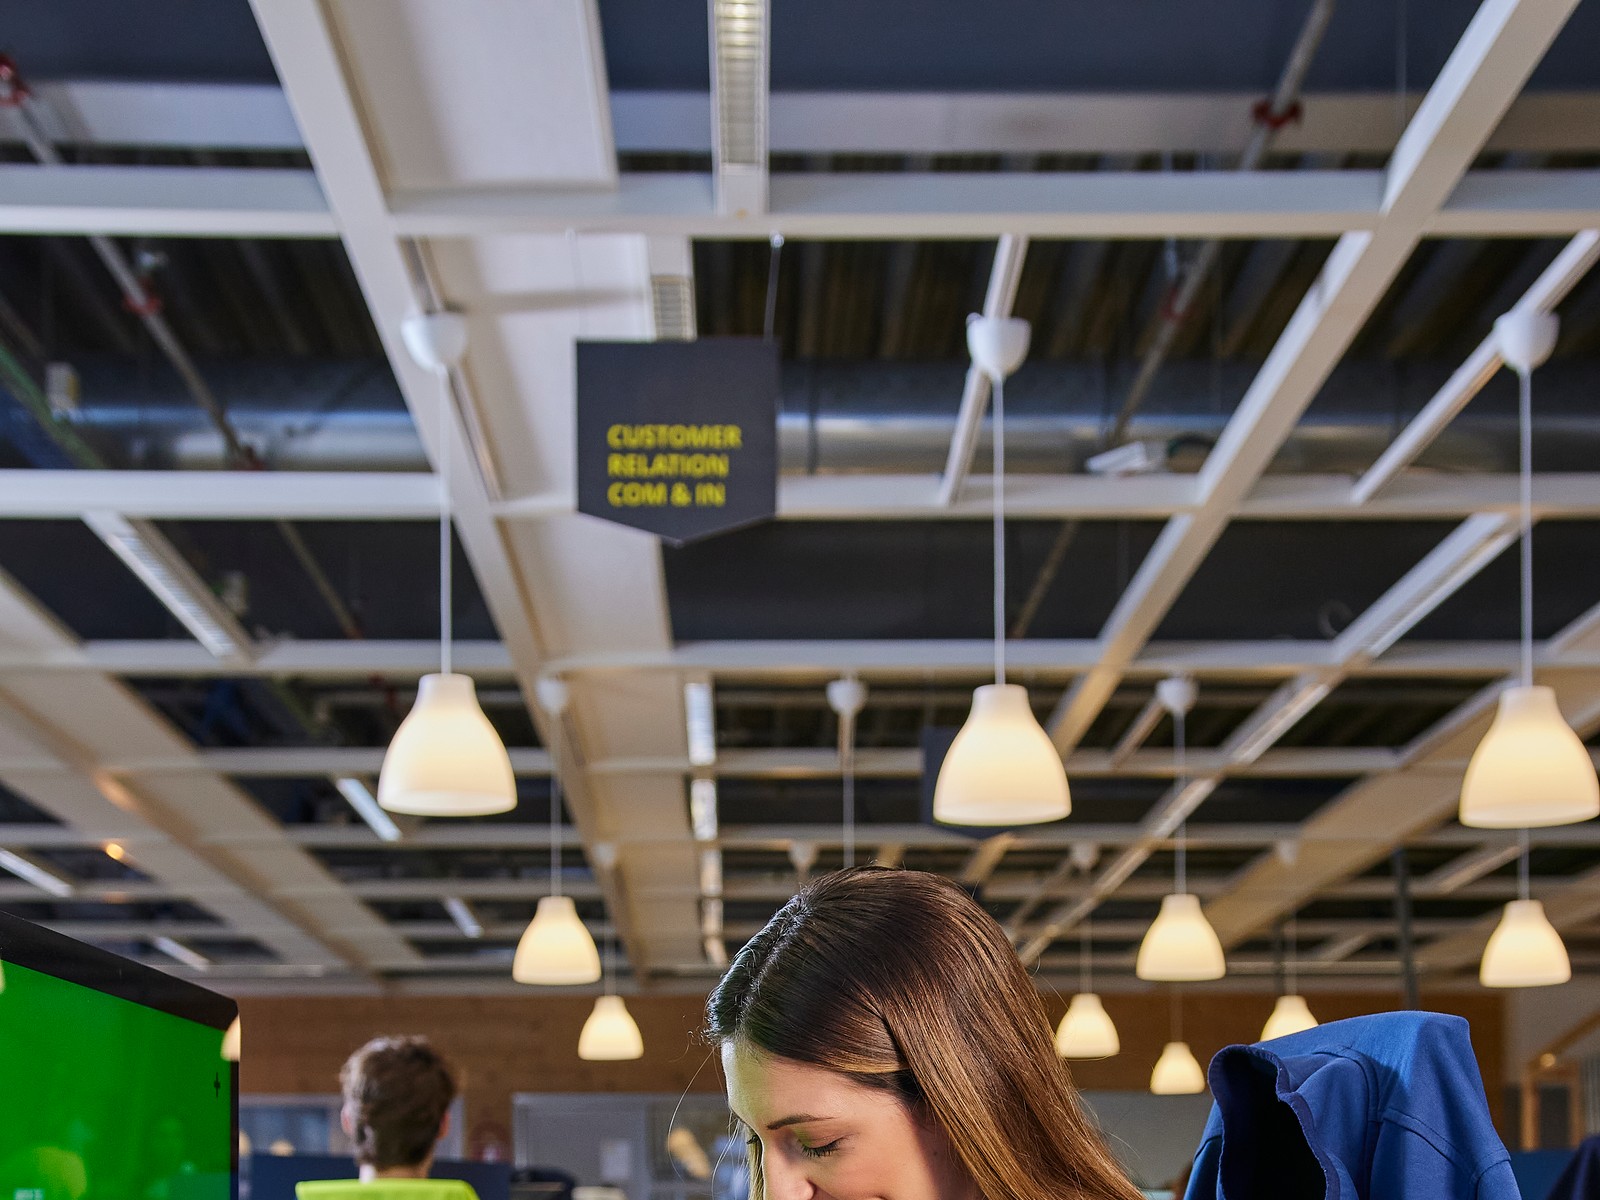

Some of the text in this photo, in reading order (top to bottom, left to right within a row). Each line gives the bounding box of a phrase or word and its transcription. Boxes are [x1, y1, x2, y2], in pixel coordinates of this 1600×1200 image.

[607, 424, 743, 449] CUSTOMER
[607, 453, 729, 478] RELATION
[607, 482, 726, 507] COM & IN
